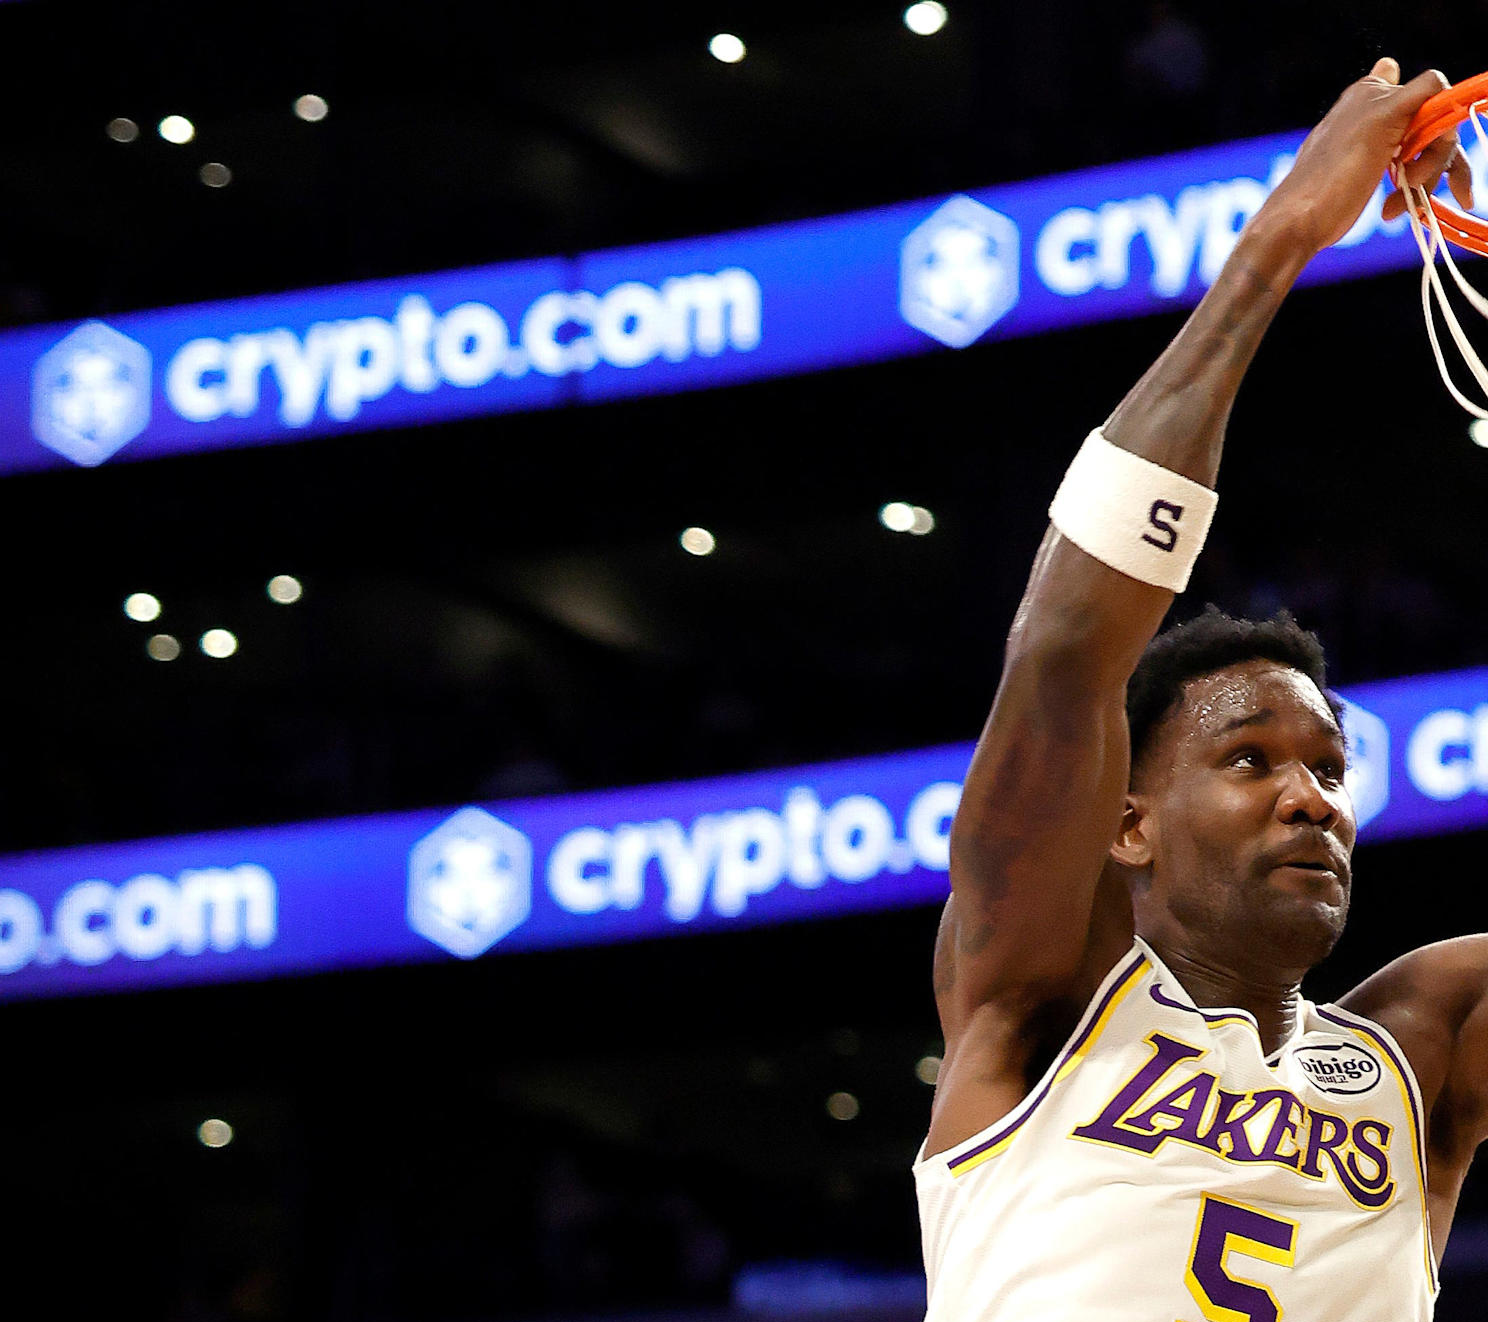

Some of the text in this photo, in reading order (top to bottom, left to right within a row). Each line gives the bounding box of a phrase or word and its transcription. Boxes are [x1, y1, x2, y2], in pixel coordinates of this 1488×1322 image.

[165, 267, 762, 428] crypto.com
[547, 781, 964, 922] crypto.c
[1066, 1030, 1397, 1211] LAKERS
